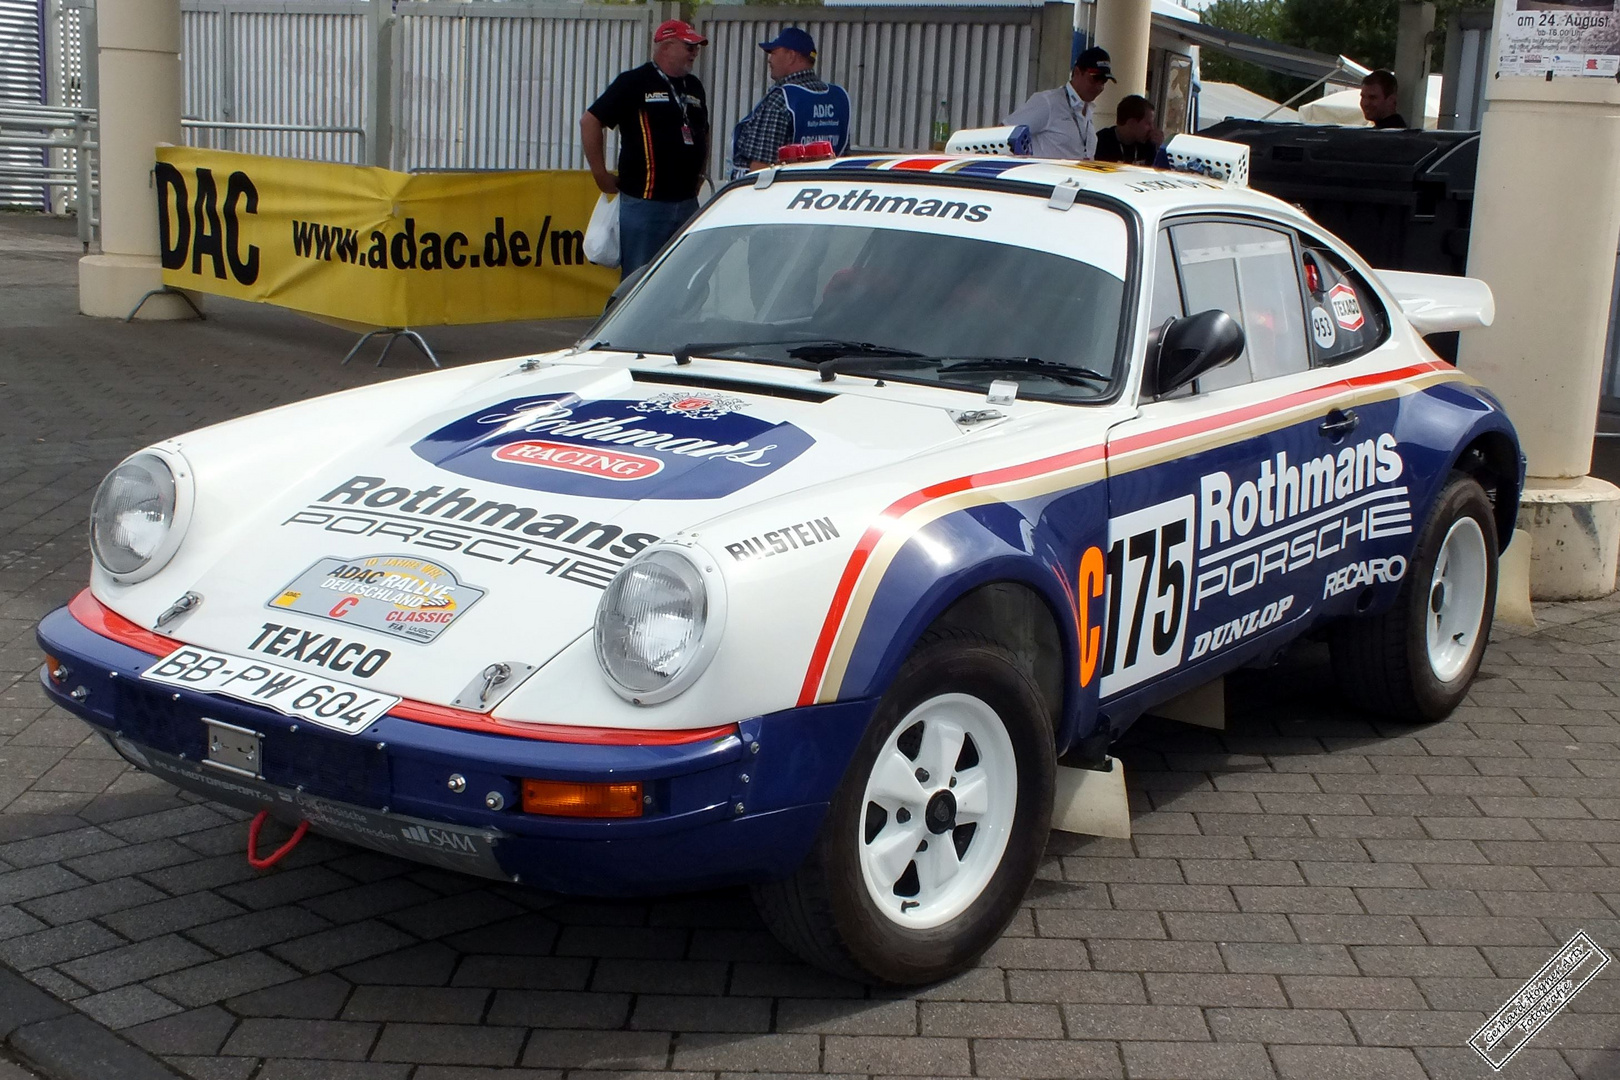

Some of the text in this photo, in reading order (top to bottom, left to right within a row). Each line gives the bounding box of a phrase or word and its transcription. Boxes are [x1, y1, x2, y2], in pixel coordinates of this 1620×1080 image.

[1517, 14, 1609, 30] am 24. August
[155, 161, 260, 286] DAC
[786, 188, 992, 224] Rothmans
[293, 216, 598, 271] www.adac.de/m
[1333, 299, 1359, 316] TEXACO
[1314, 317, 1332, 337] 953
[477, 399, 778, 468] Rothmans
[509, 444, 646, 476] RACING
[1200, 432, 1403, 551] Rothmans
[317, 475, 661, 559] Rothmans
[280, 511, 626, 590] PORSCHE
[382, 558, 423, 570] JAHRE
[1195, 501, 1412, 610] PORSCHE
[320, 578, 426, 609] DEUTSCHLAND
[327, 564, 456, 600] ADAC RALLYE
[1323, 555, 1407, 600] RECARO
[329, 597, 360, 618] C
[385, 611, 453, 624] CLASSIC
[1079, 519, 1188, 688] C 175
[388, 622, 404, 632] FIA
[1188, 595, 1294, 661] DUNLOP
[247, 623, 392, 679] TEXACO
[151, 651, 382, 727] BB-PW 604
[353, 823, 399, 842] Dresden
[428, 828, 477, 853] SAM
